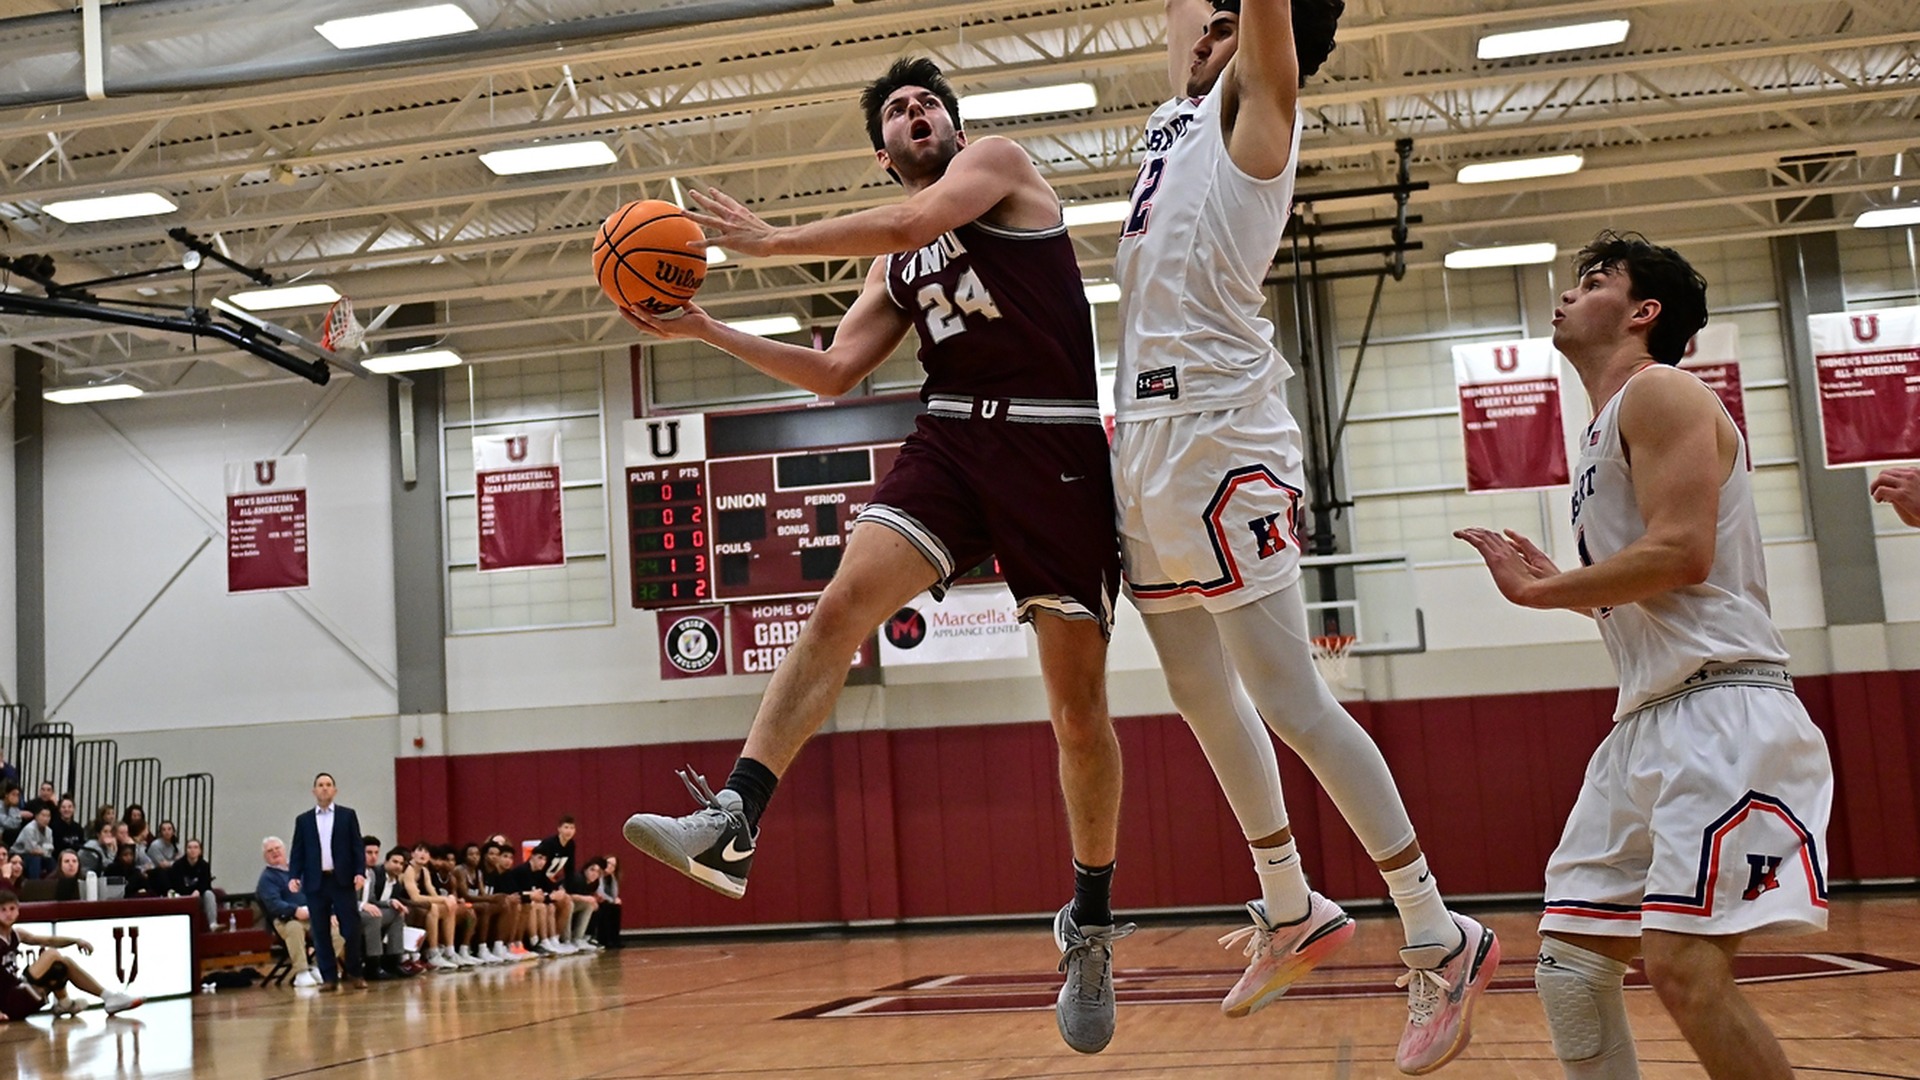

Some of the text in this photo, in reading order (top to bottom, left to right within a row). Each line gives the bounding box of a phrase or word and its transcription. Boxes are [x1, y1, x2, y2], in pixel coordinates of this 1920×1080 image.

[917, 264, 1003, 345] 24
[1850, 314, 1880, 343] U
[1493, 345, 1518, 373] U
[1862, 352, 1920, 365] BASKETBALL
[1502, 382, 1557, 395] BASKETBALL
[1474, 392, 1547, 408] LIBERTY LEAGUE
[981, 400, 998, 419] U
[1486, 405, 1537, 419] CHAMPIONS
[646, 420, 681, 460] U
[505, 435, 529, 462] U
[254, 460, 277, 485] U
[507, 470, 553, 481] BASKETBALL
[630, 467, 699, 482] PLYR F PTS
[256, 494, 299, 505] BASKETBALL
[661, 484, 672, 500] 0
[804, 493, 846, 506] PERIOD
[715, 493, 767, 510] UNION
[662, 508, 673, 525] 0
[692, 506, 702, 523] 2
[776, 508, 803, 520] POSS
[777, 524, 810, 536] BONUS
[663, 532, 675, 550] 0
[692, 530, 703, 547] 0
[798, 535, 840, 548] PLAYER
[715, 542, 751, 555] FOULS
[671, 558, 677, 573] 1
[695, 554, 705, 572] 3
[672, 582, 678, 598] 1
[695, 579, 706, 597] 2
[752, 602, 816, 618] HOME OF
[678, 620, 705, 630] UNION
[932, 624, 1021, 638] APPLIANCE CENTER
[754, 620, 811, 647] GAR
